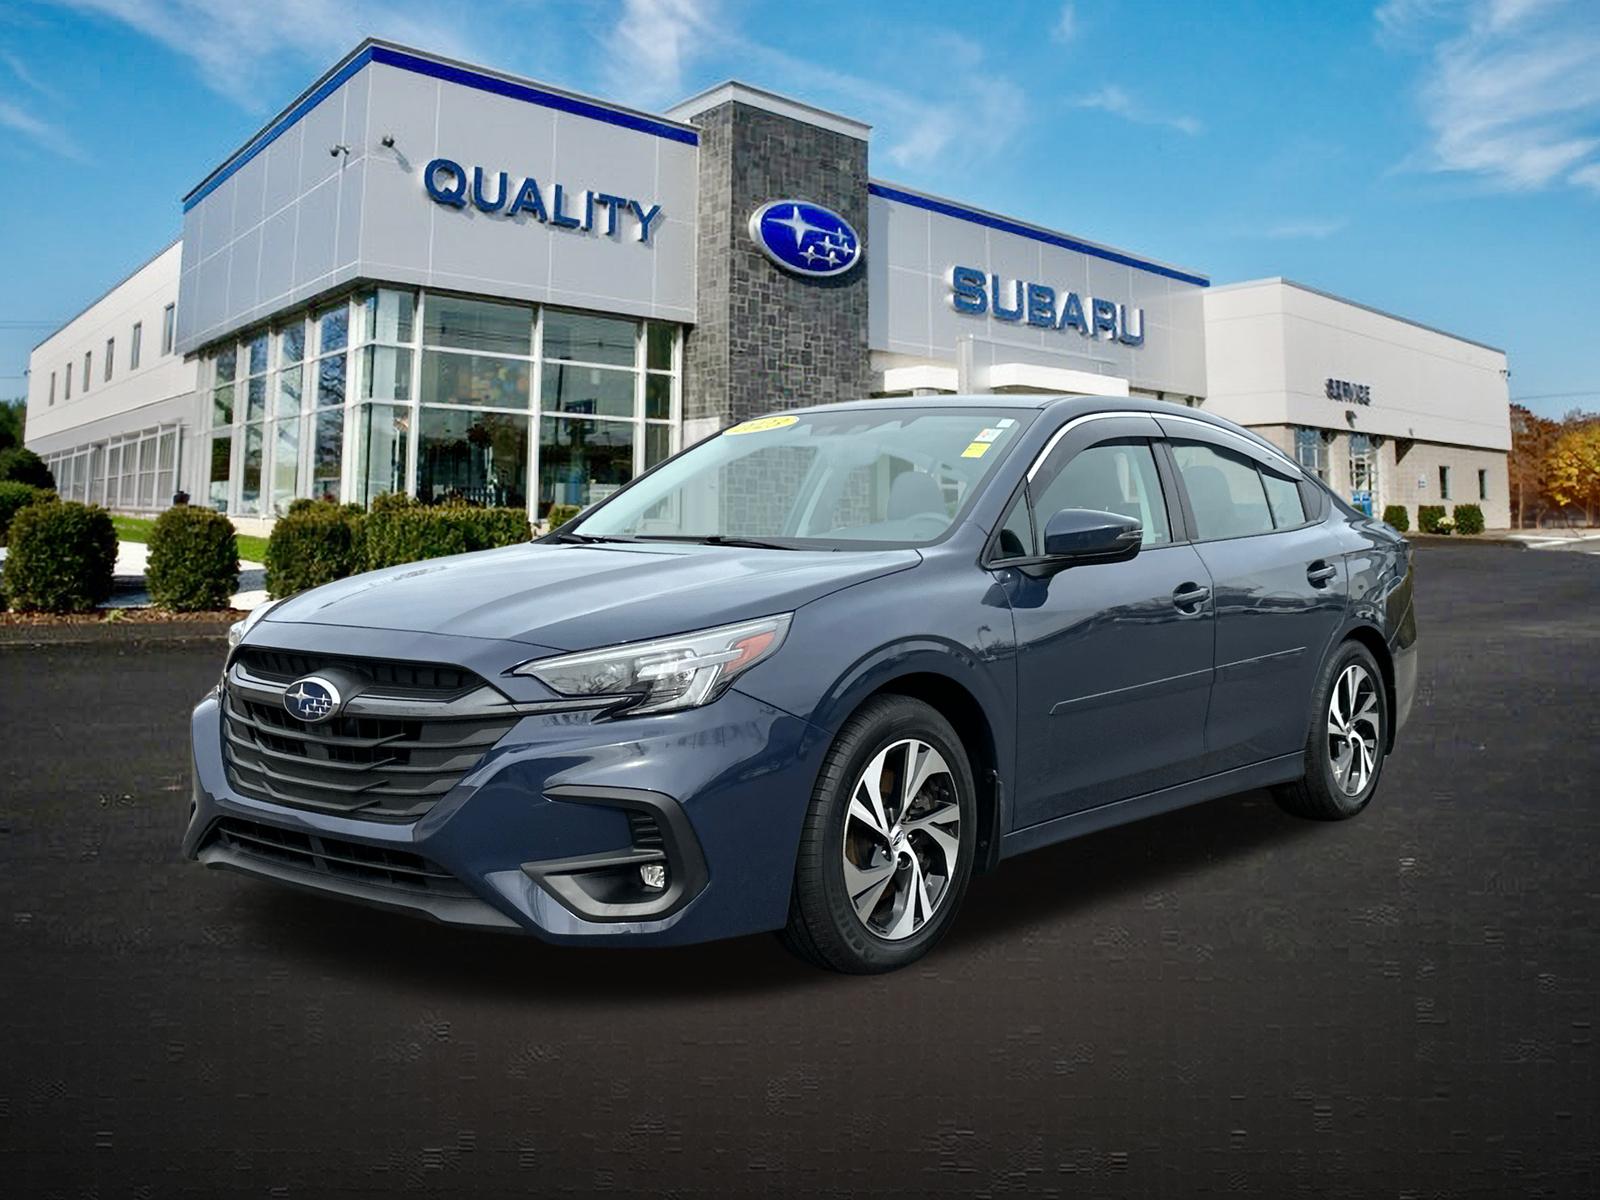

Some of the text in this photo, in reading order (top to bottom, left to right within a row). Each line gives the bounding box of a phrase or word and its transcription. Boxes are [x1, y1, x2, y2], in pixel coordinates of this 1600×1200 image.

[424, 158, 661, 242] QUALITY
[950, 265, 1145, 346] SUBARU
[1325, 378, 1371, 406] SERVICE
